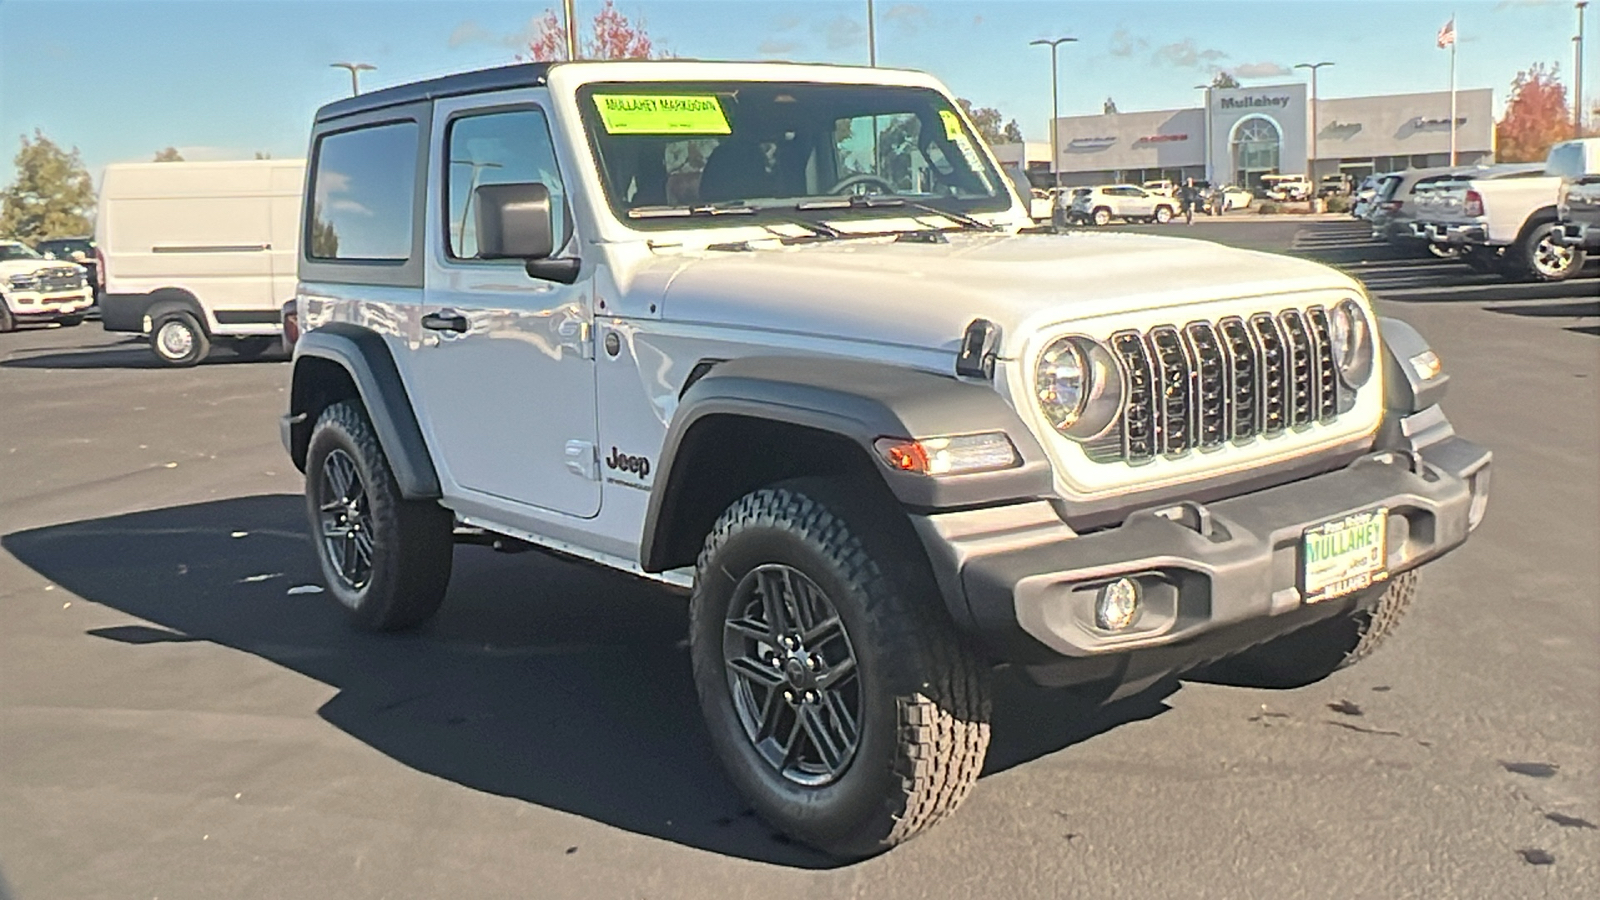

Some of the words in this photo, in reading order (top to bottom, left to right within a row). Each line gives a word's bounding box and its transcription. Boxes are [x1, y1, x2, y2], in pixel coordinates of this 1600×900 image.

[605, 99, 657, 112] MULLAHEY
[660, 99, 717, 112] MARKDOWN
[1221, 95, 1289, 108] Mullahey
[606, 446, 650, 480] Jeep
[1306, 523, 1380, 562] MULLAHEY
